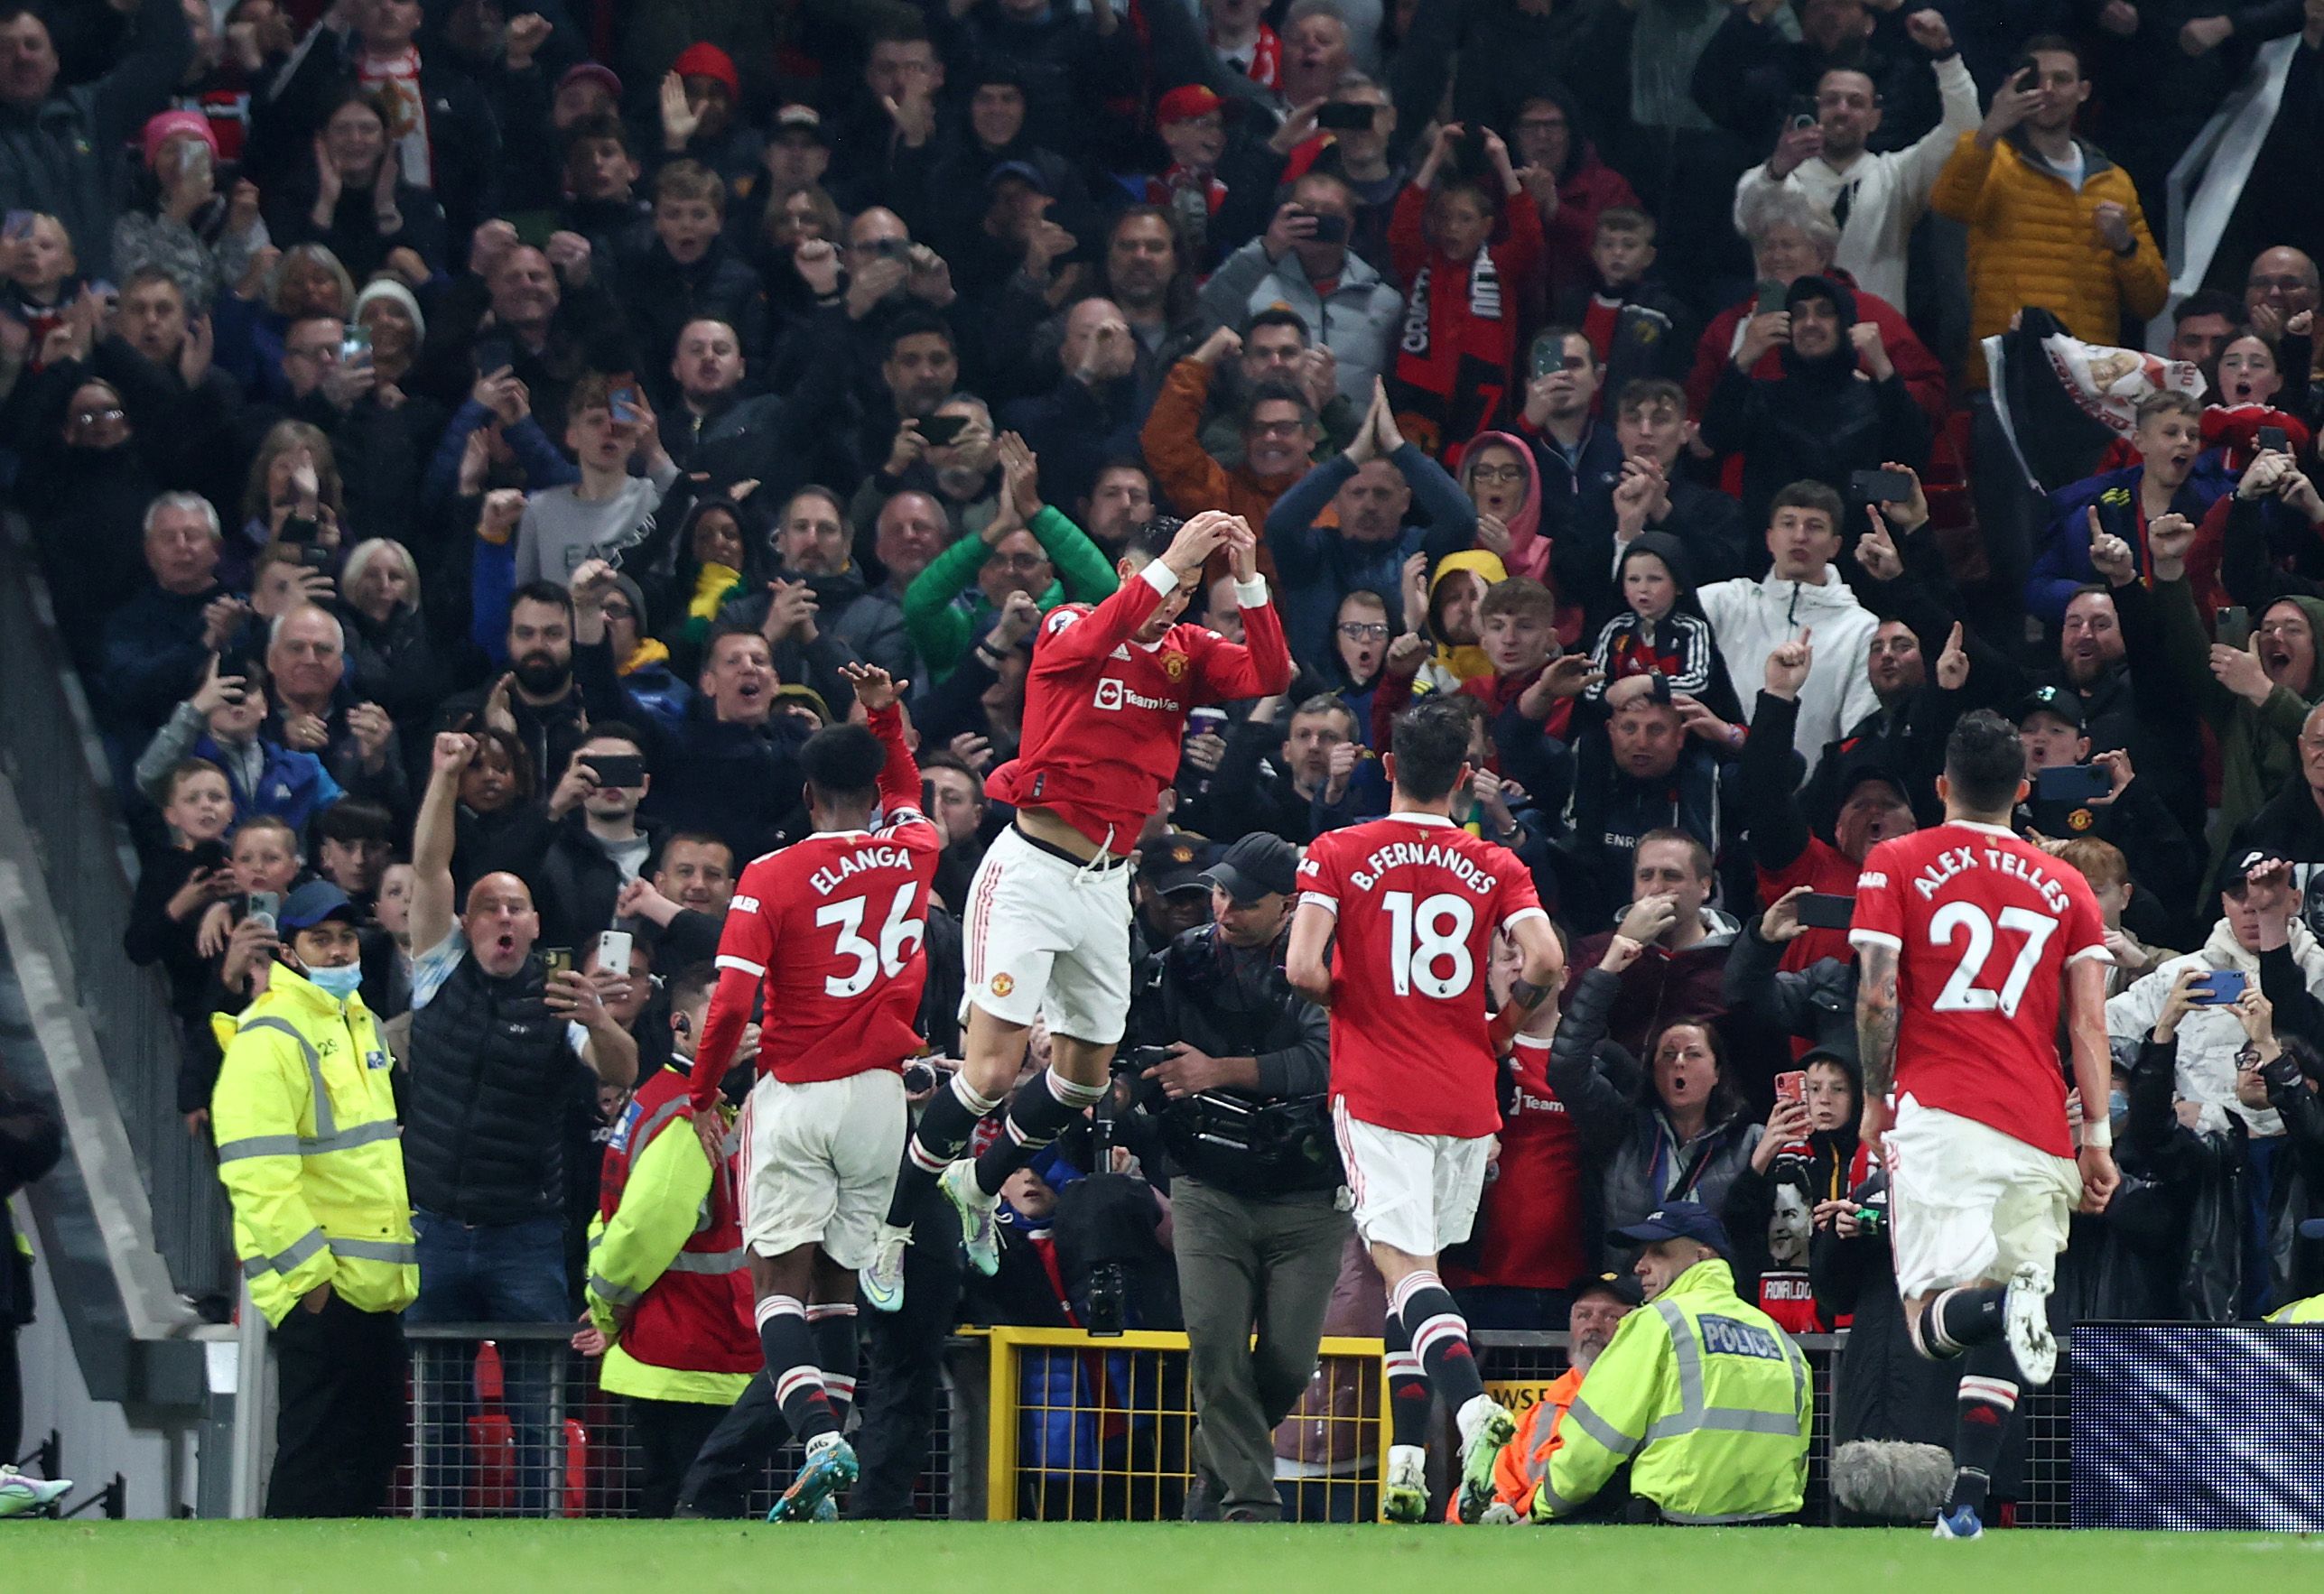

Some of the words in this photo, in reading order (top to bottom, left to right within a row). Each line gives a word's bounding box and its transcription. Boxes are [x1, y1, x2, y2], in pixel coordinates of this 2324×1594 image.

[1605, 832, 1641, 848] ENR
[2240, 851, 2264, 867] P
[809, 845, 914, 896] ELANGA
[1350, 841, 1497, 895] B.FERNANDES
[1913, 845, 1979, 902] ALEX
[1984, 848, 2071, 914] TELLES
[815, 880, 925, 998] 36
[1380, 889, 1475, 999] 18
[1929, 900, 2060, 1019] 27
[1523, 1094, 1565, 1113] Team
[1703, 1321, 1781, 1359] POLICE
